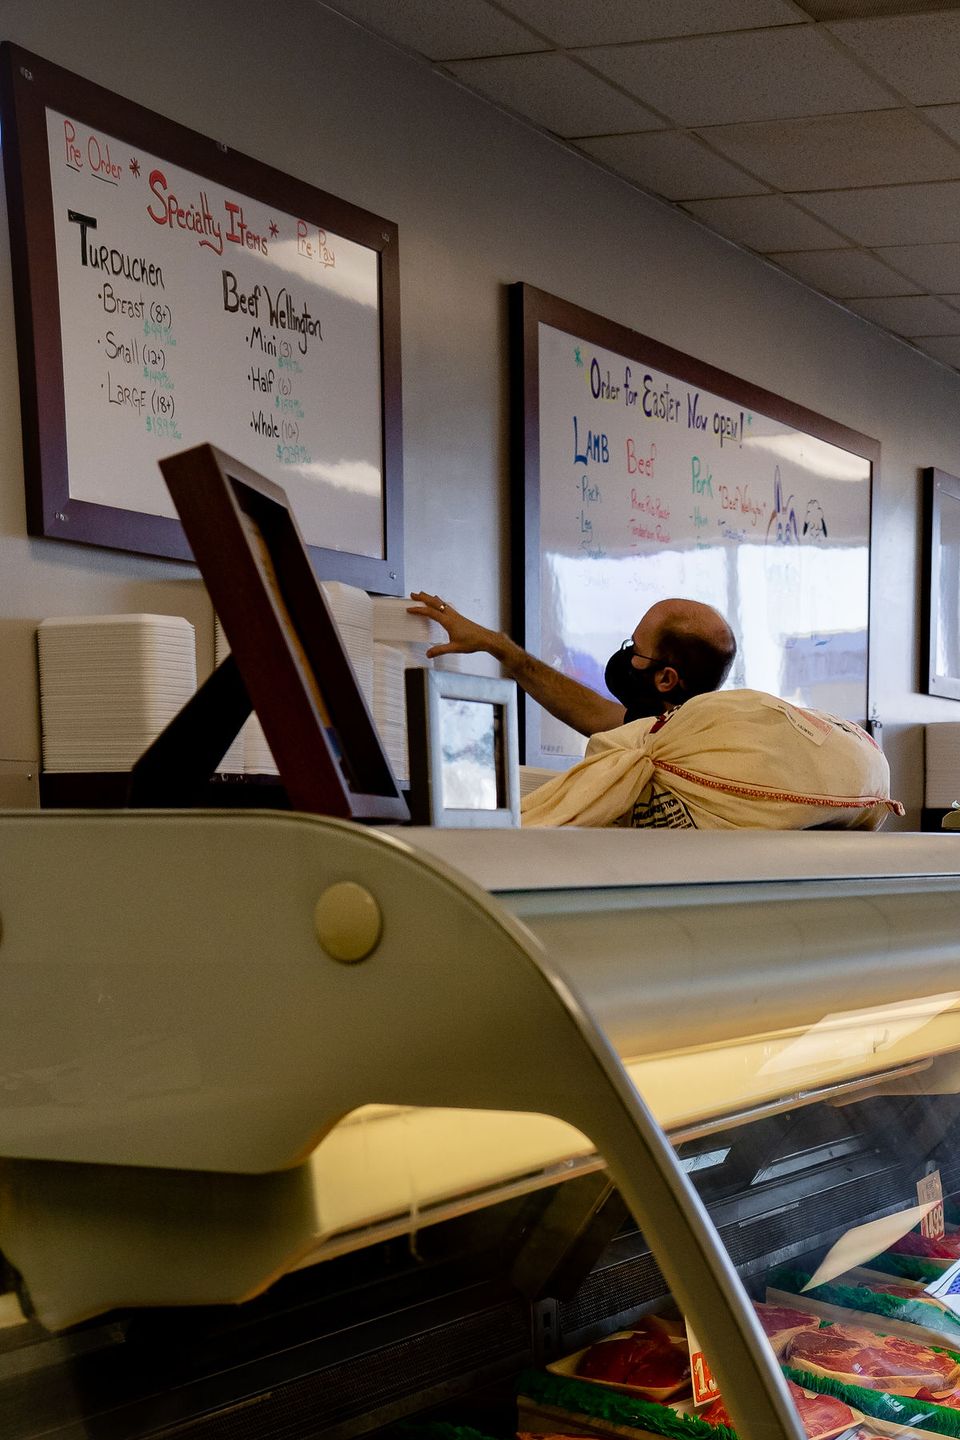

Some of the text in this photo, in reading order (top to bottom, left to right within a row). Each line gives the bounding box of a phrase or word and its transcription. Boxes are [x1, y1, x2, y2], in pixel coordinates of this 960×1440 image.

[64, 120, 122, 179] Pre Order
[147, 169, 268, 256] Specialty Items
[150, 301, 172, 329] (8+)
[222, 269, 323, 355] Beef Wellington
[105, 331, 139, 365] Small
[250, 327, 276, 357] Mini
[251, 367, 275, 393] Half
[590, 357, 620, 400] Order
[624, 366, 638, 406] for
[643, 374, 681, 423] Easter
[687, 393, 708, 431] Now
[151, 389, 175, 419] (18+)
[252, 410, 280, 438] Whole
[573, 416, 610, 466] LAMB
[626, 438, 657, 478] Beef
[691, 455, 713, 498] Pork
